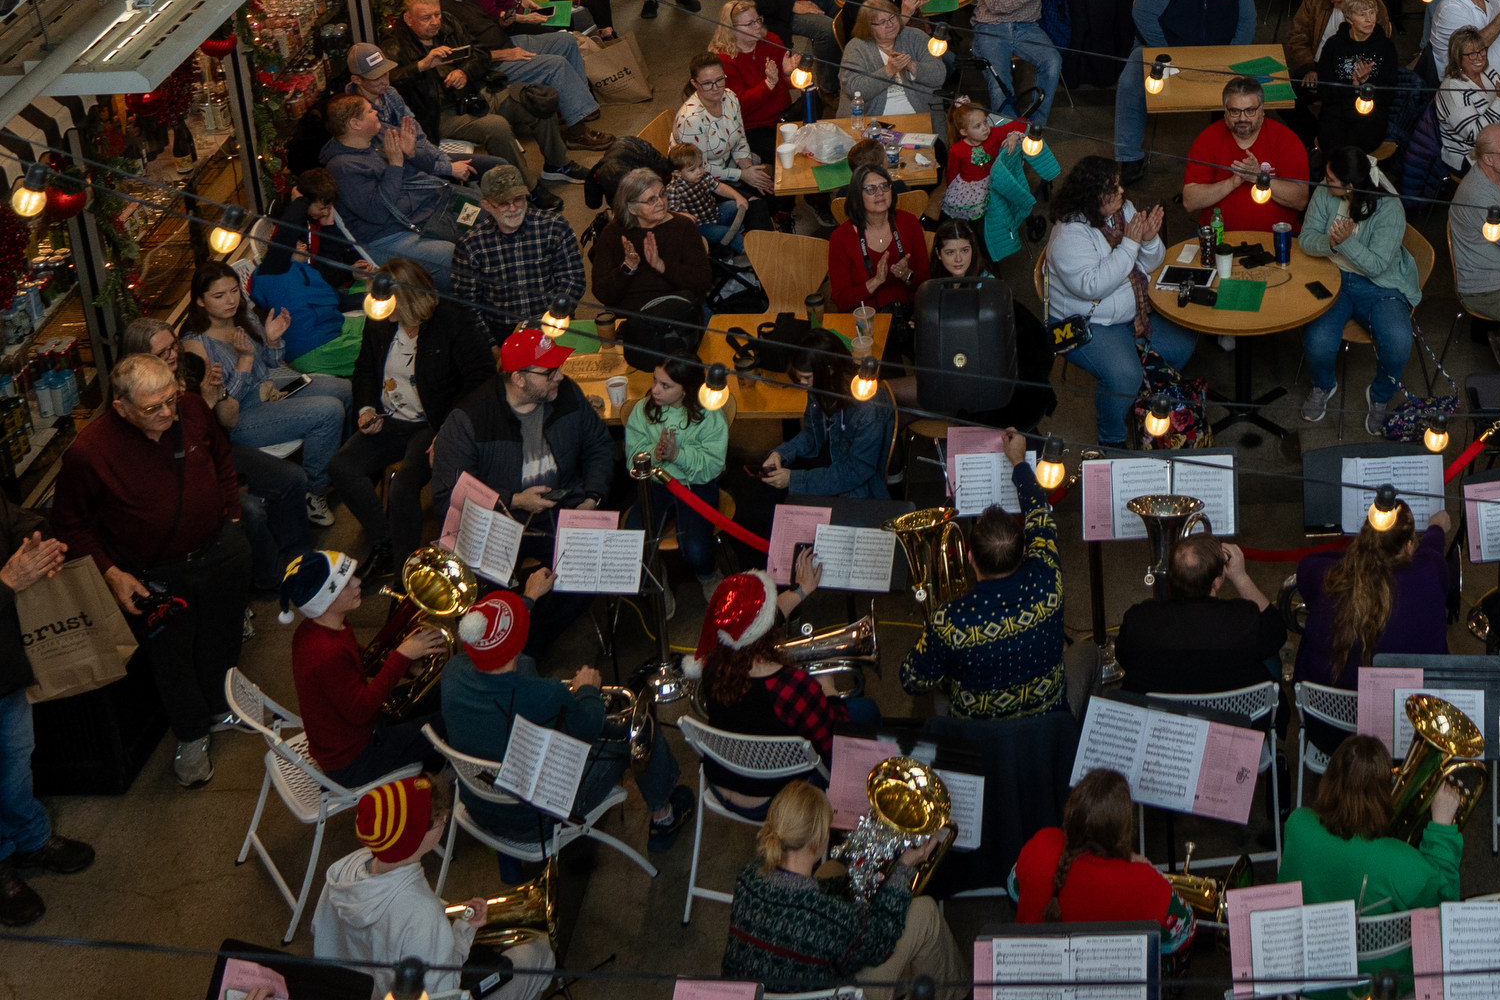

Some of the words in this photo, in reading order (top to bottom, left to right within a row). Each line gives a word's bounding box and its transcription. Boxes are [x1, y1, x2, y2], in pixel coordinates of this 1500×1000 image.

[595, 66, 632, 88] crust
[1053, 322, 1075, 345] M
[20, 611, 93, 647] crust
